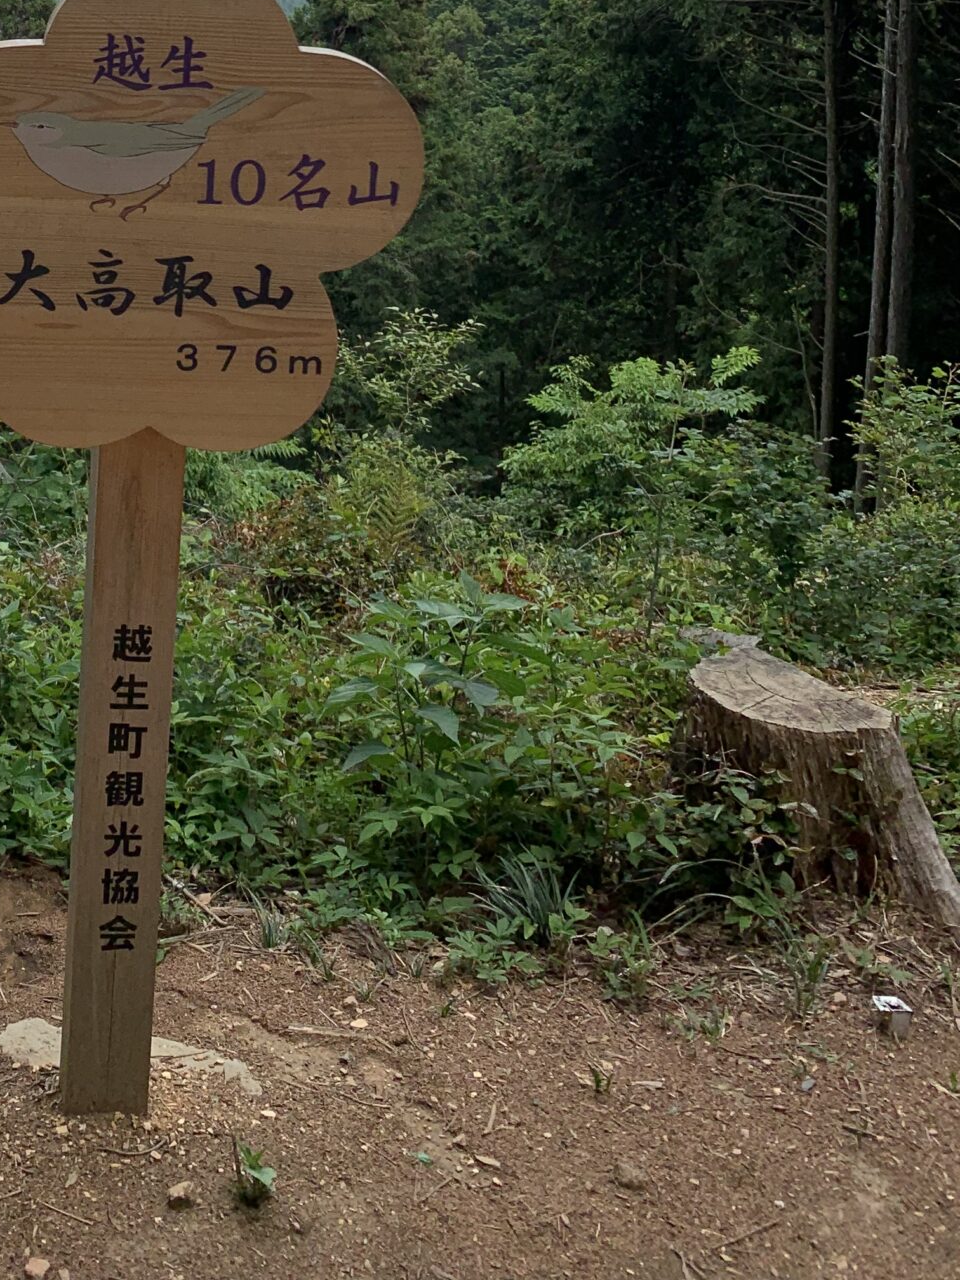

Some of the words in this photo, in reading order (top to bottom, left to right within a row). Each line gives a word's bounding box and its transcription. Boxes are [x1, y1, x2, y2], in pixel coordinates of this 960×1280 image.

[91, 32, 215, 92] 越生
[196, 153, 400, 211] 10名山
[175, 342, 323, 376] 376m
[99, 623, 153, 952] 越生町観光協会
